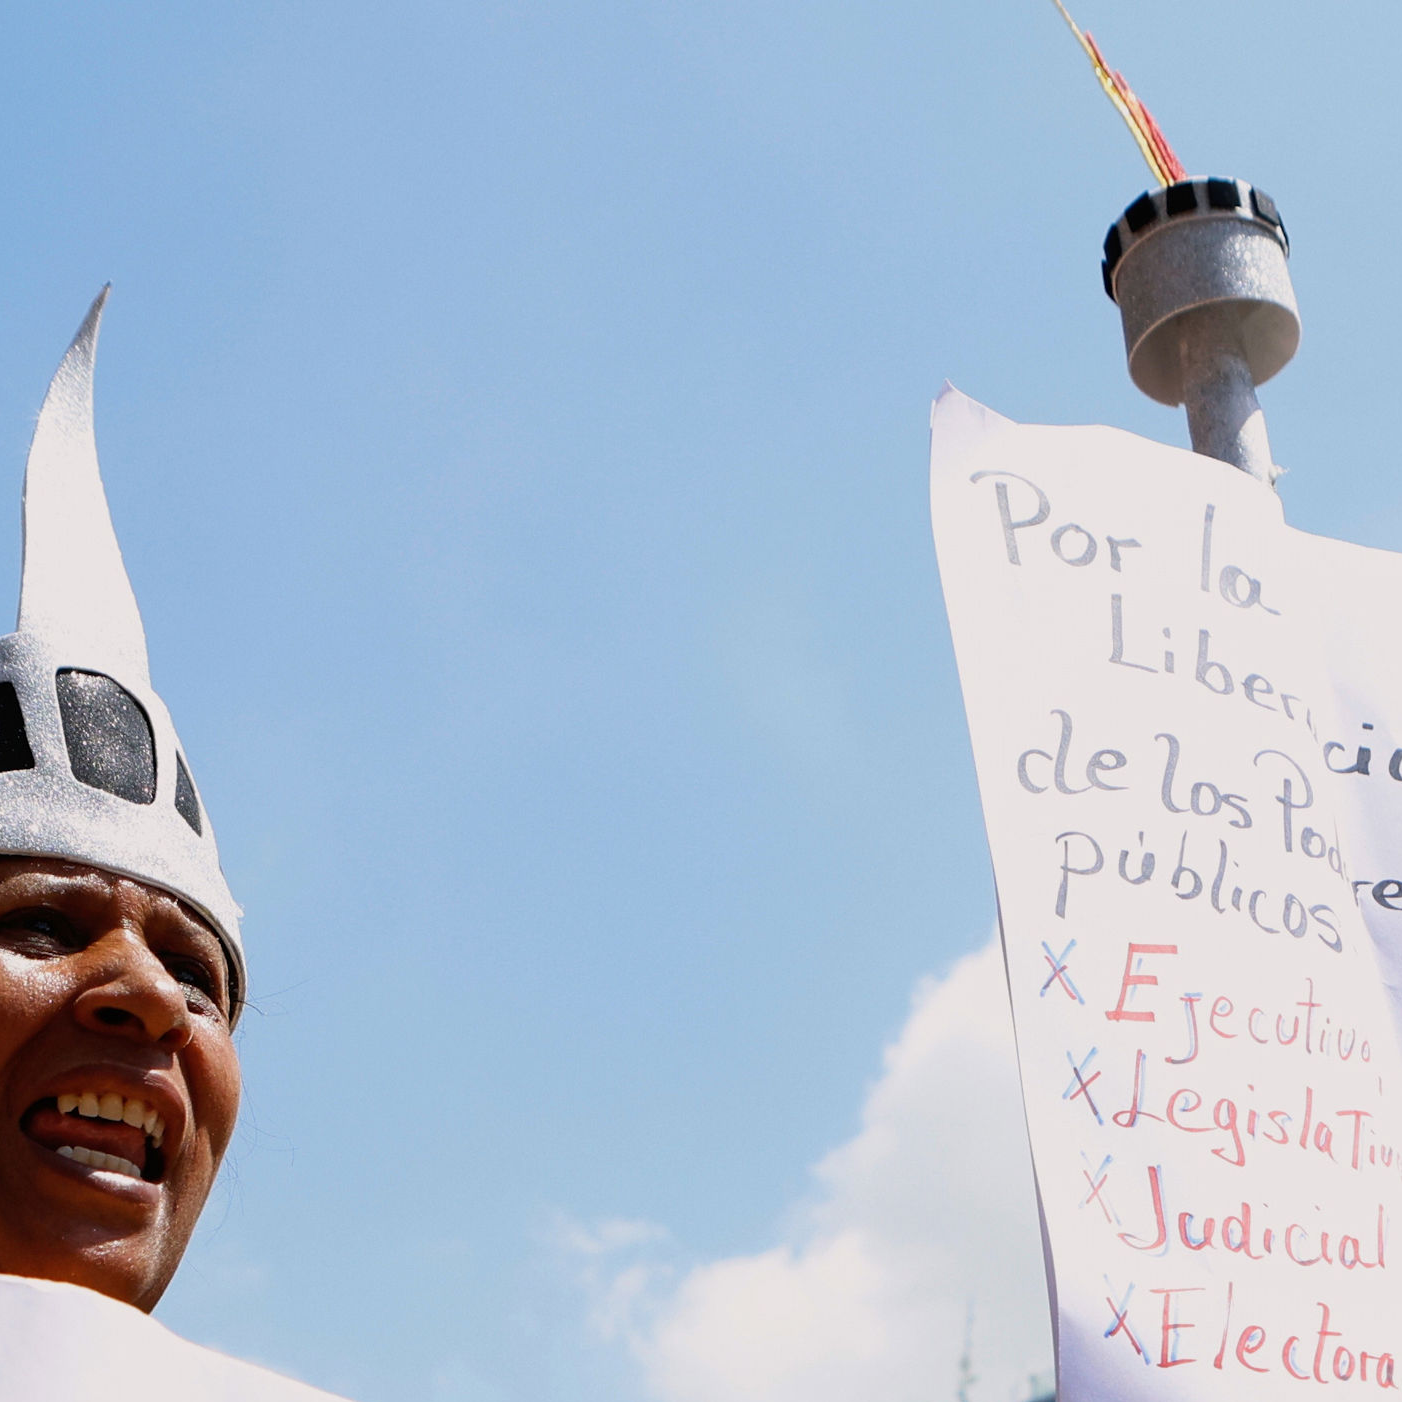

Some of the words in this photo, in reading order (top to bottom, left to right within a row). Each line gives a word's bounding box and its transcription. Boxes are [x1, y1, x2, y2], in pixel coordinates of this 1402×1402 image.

[969, 470, 1143, 573] Por
[1199, 502, 1282, 617] la
[1016, 709, 1129, 797] de
[1154, 731, 1253, 830] los
[1116, 1163, 1392, 1271] Judicial
